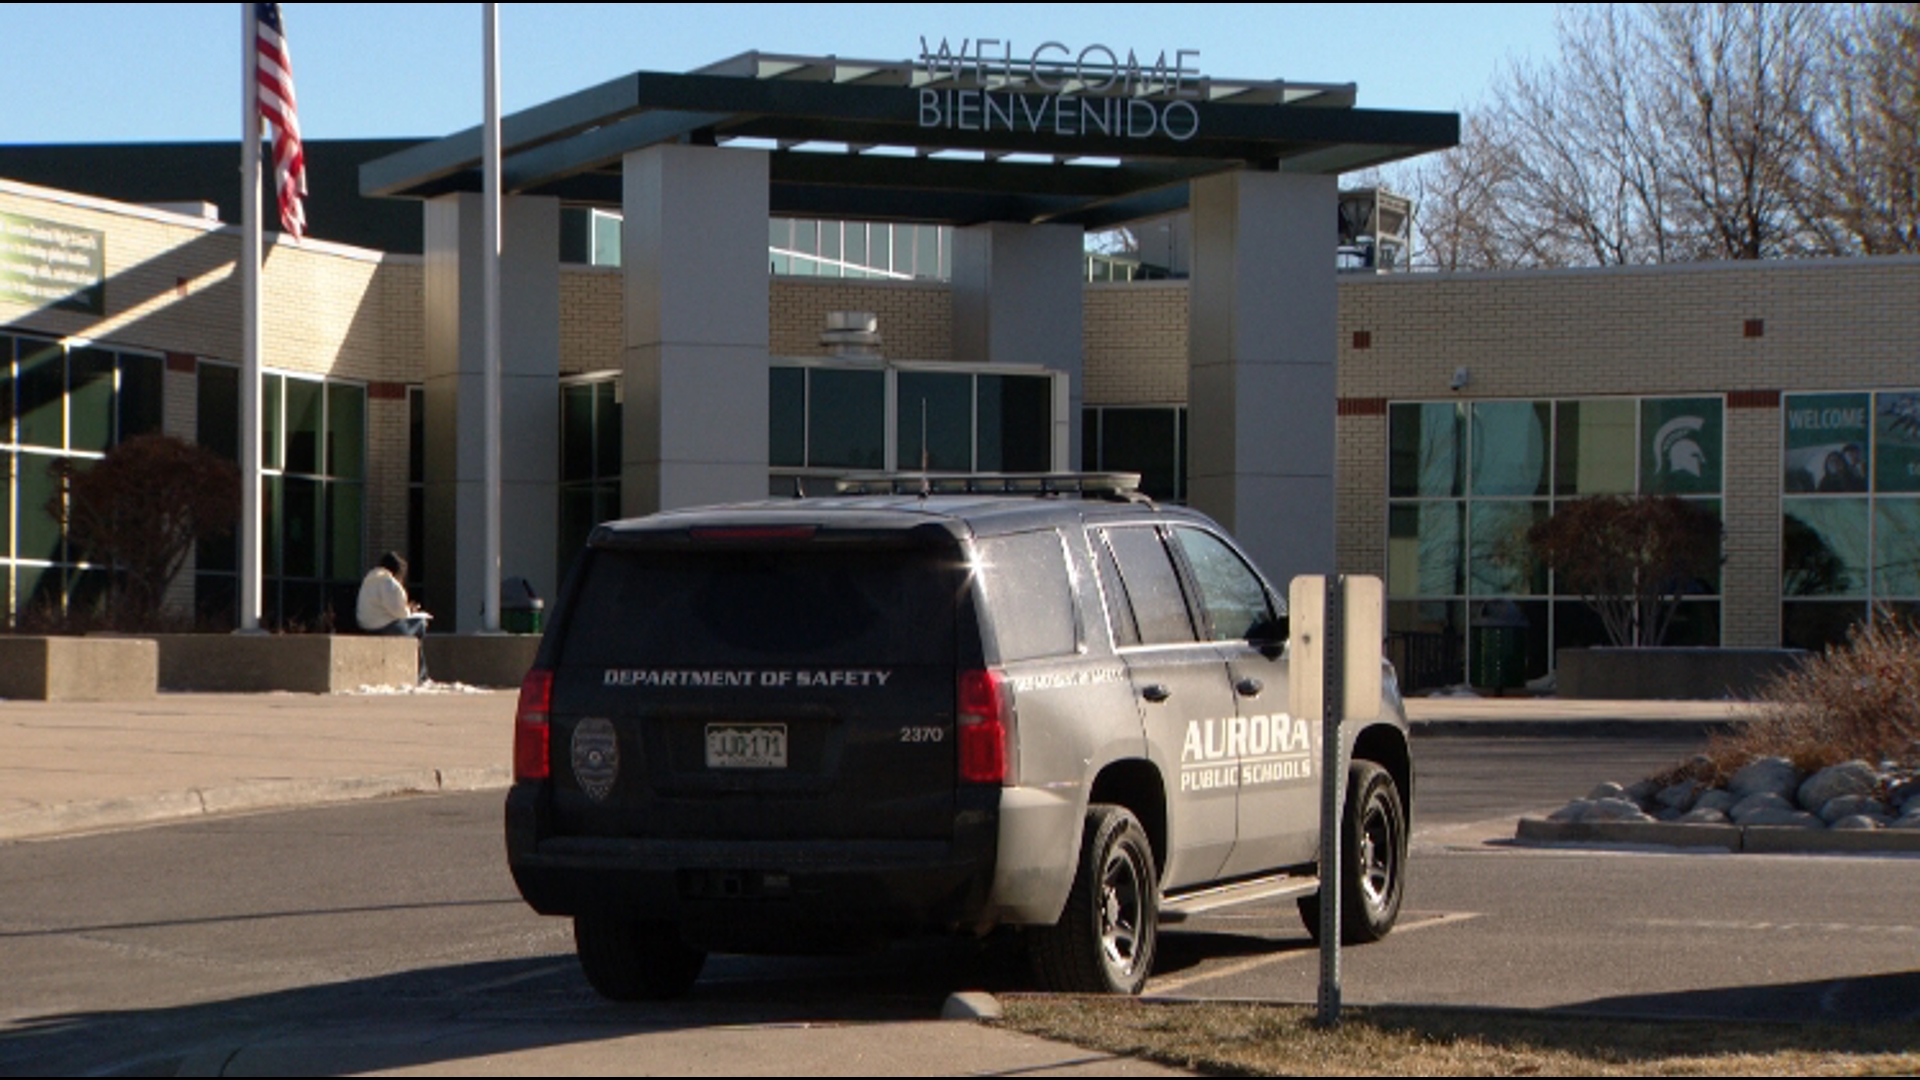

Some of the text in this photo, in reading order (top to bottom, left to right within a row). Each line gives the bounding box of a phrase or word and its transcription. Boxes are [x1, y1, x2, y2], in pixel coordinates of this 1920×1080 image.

[919, 35, 1200, 96] WELCOME
[919, 88, 1199, 140] BIENVENIDO
[1789, 407, 1865, 430] WELCOME
[602, 668, 892, 687] DEPARTMENT OF SAFETY
[900, 726, 944, 742] 2370
[1180, 712, 1311, 764] AURORA
[1181, 758, 1311, 792] PUBLIC SCHOOLS
